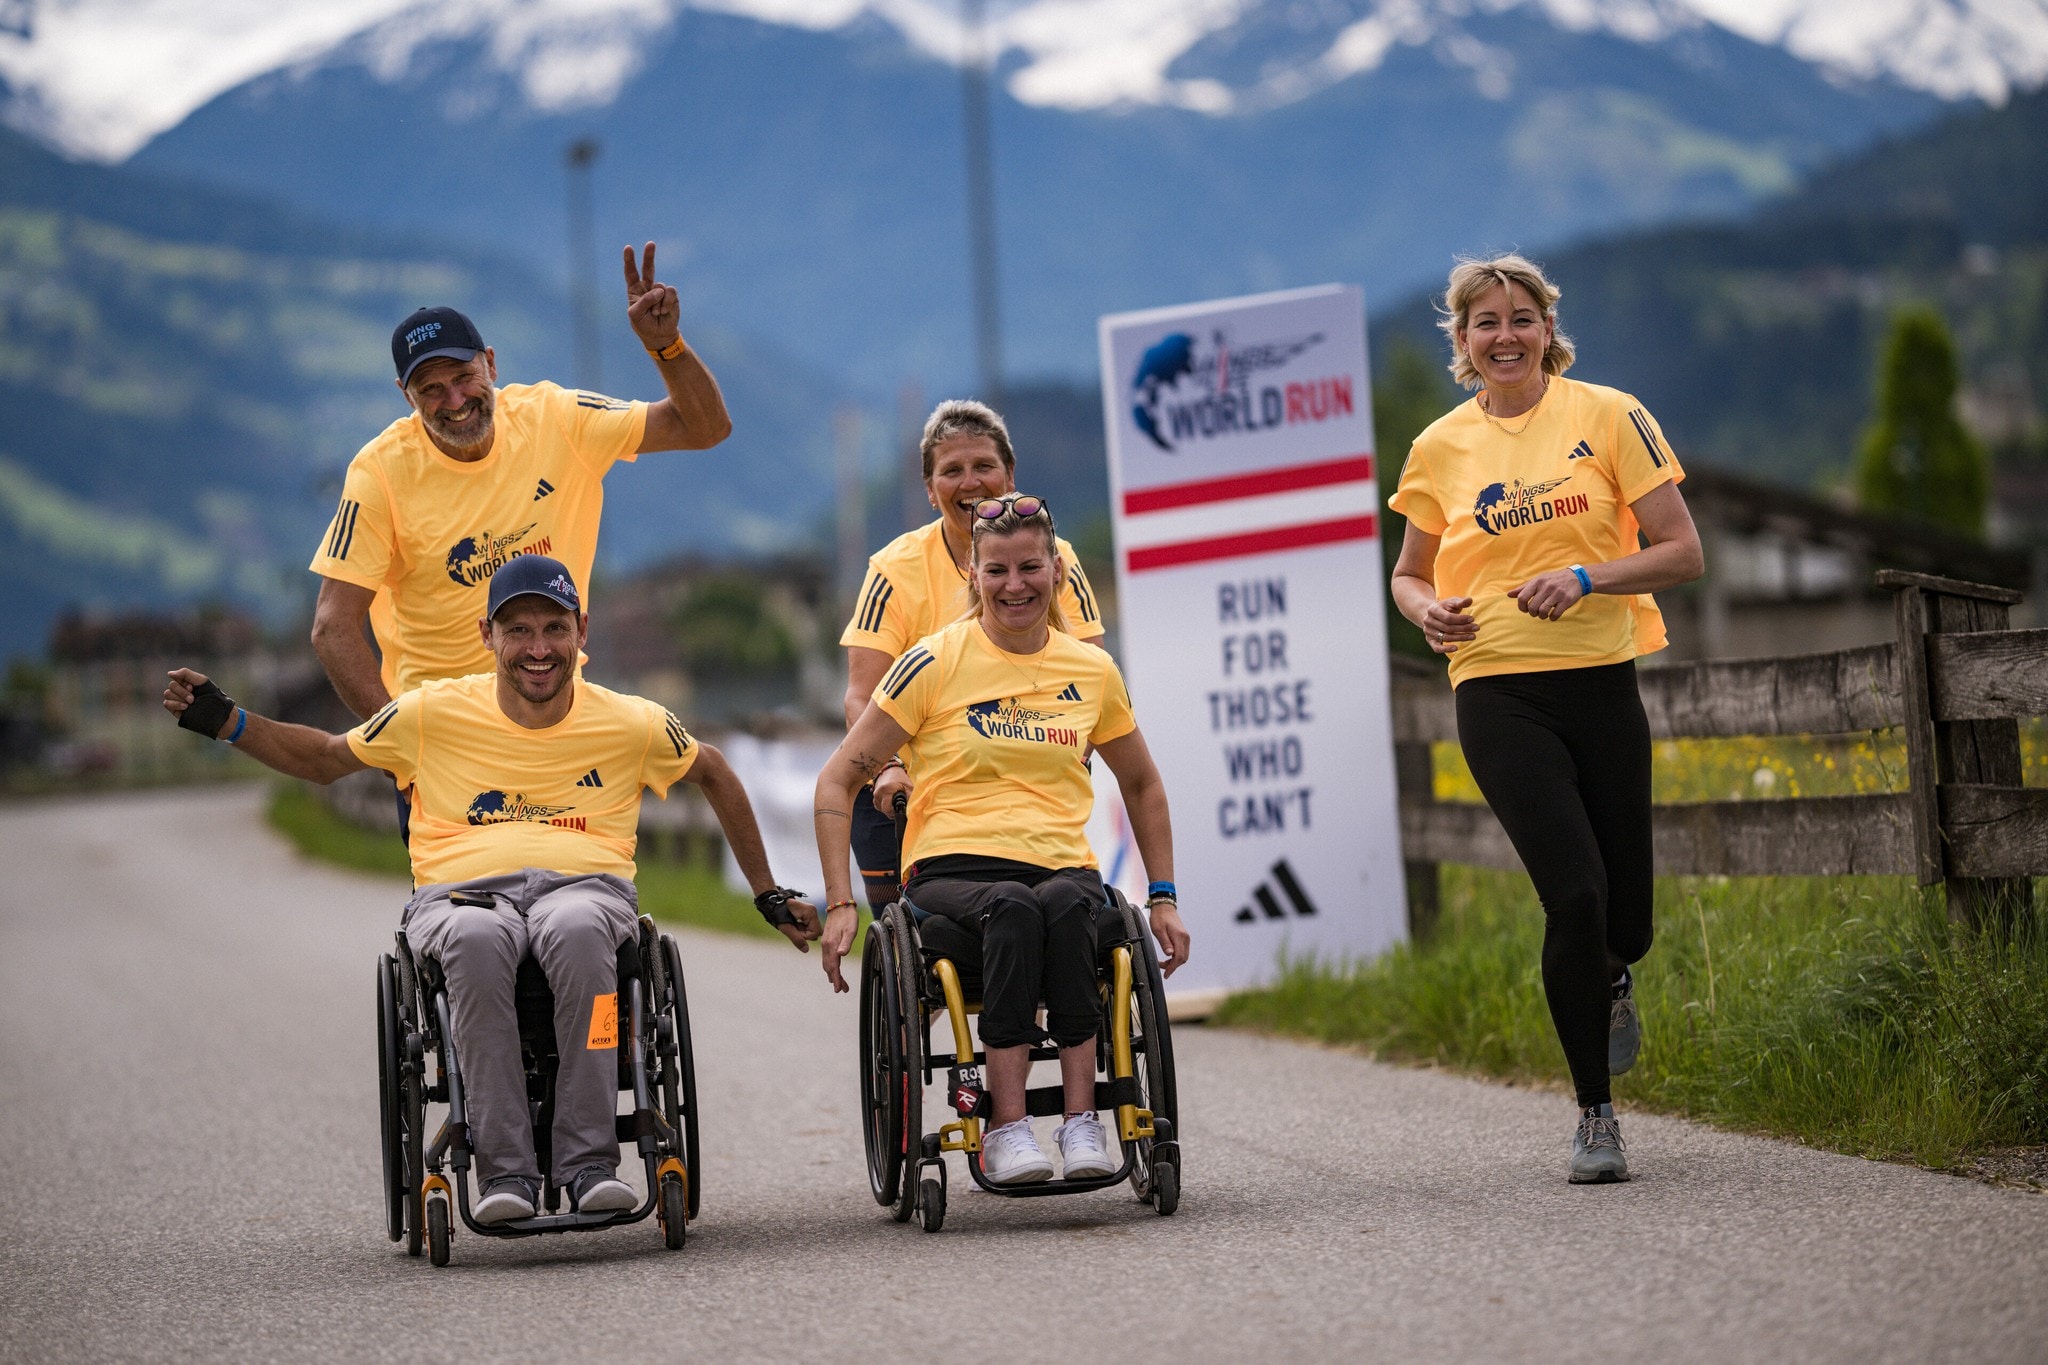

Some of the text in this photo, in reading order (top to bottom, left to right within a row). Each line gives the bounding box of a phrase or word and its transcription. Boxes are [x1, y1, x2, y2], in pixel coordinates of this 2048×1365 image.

[405, 322, 442, 342] WINGS
[412, 330, 437, 346] LIFE
[1504, 484, 1546, 501] WINGS
[1512, 496, 1535, 509] LIFE
[477, 533, 515, 554] WINGS
[485, 547, 506, 561] LIFE
[1219, 577, 1287, 623] RUN
[1222, 629, 1288, 676] FOR
[1000, 706, 1040, 720] WINGS
[1208, 679, 1313, 731] THOSE
[1006, 717, 1028, 725] LIFE
[1224, 735, 1303, 781] WHO
[504, 803, 548, 816] WINGS
[1218, 786, 1313, 842] CAN'T
